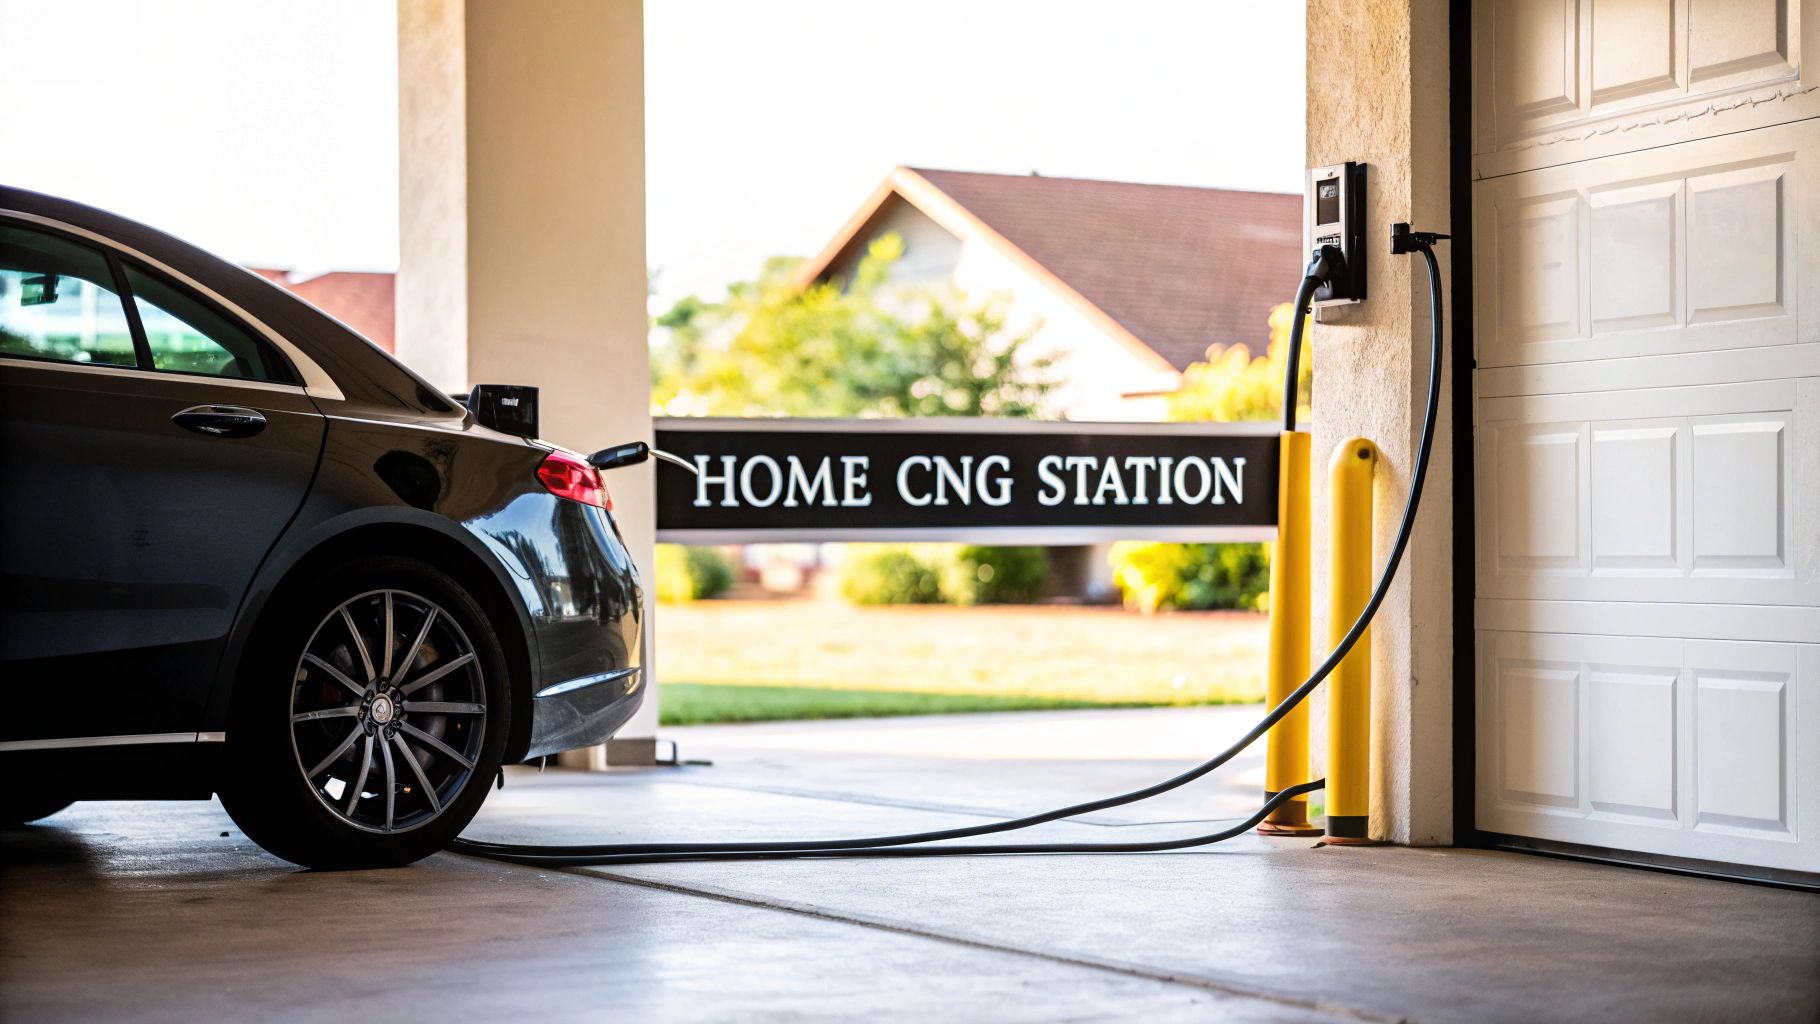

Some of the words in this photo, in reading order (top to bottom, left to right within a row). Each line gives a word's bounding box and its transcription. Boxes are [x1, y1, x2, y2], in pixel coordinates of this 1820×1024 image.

[693, 454, 872, 508] HOME
[896, 454, 1014, 507] CNG
[1037, 455, 1247, 507] STATION
